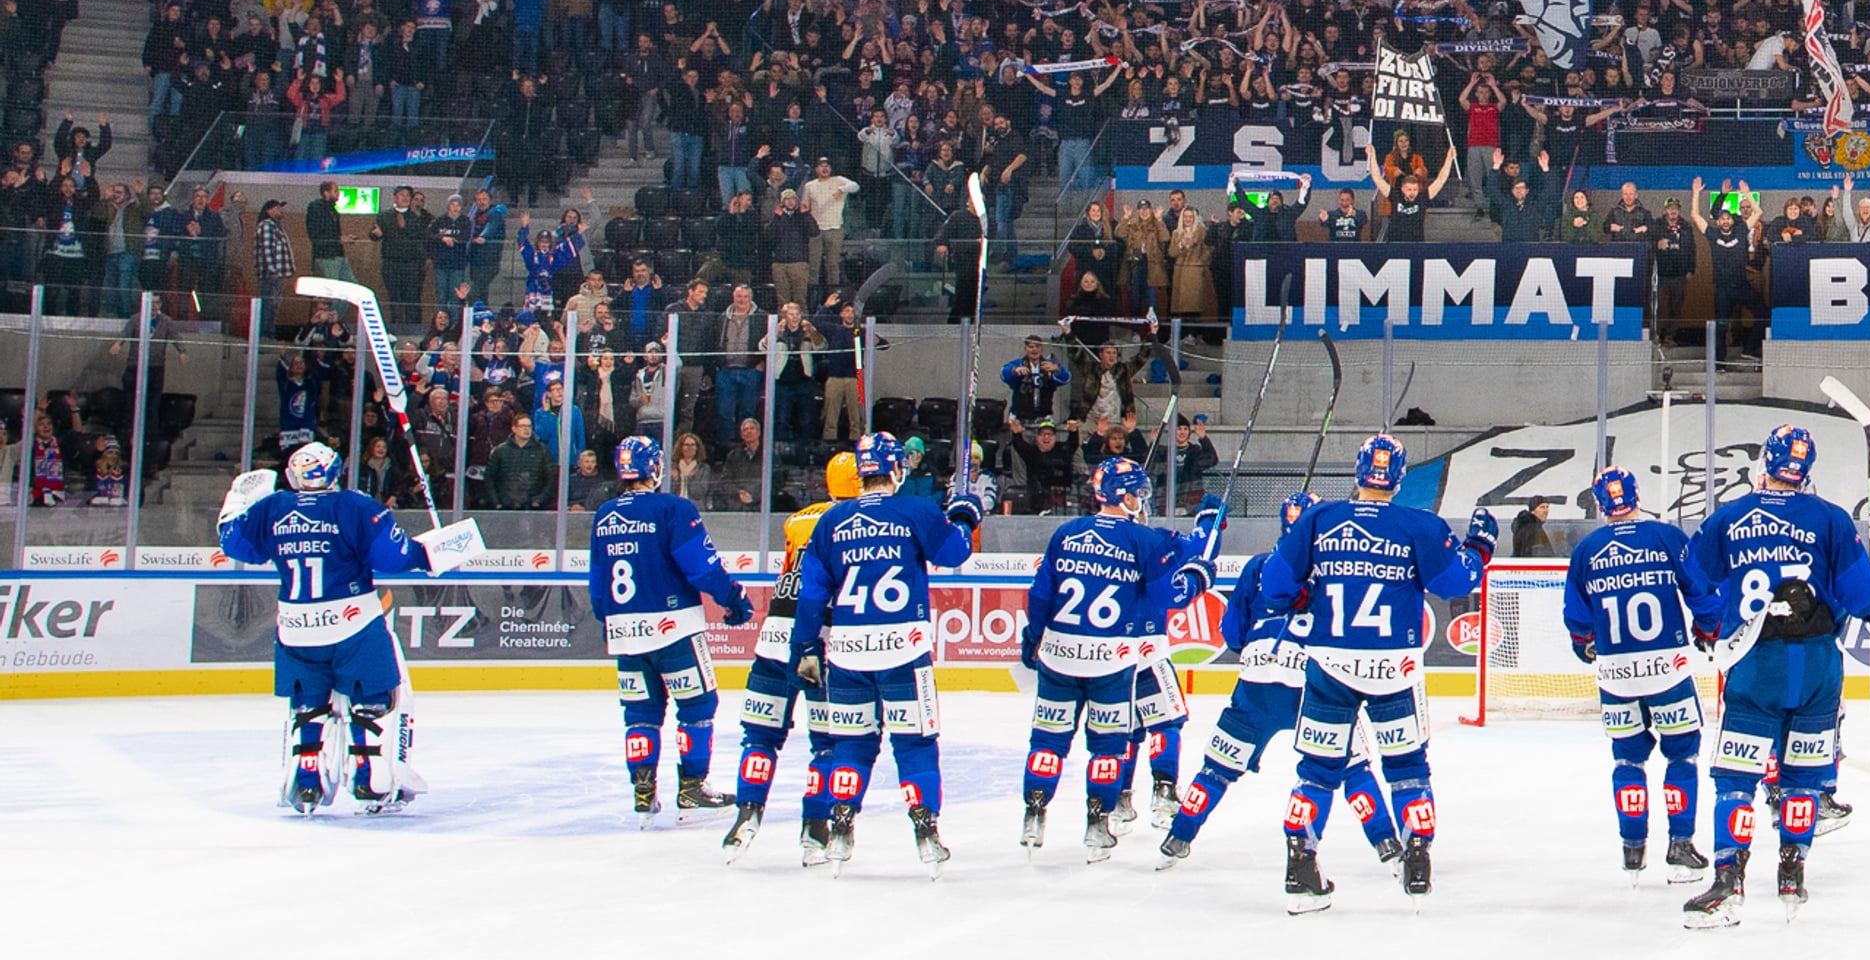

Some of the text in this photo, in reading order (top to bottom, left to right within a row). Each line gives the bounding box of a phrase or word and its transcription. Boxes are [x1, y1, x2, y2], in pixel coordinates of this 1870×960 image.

[1455, 44, 1511, 52] DIVISIN
[1544, 98, 1602, 106] DIVISIN
[1401, 102, 1444, 123] ALL
[1245, 258, 1633, 326] LIMMAT
[1727, 522, 1816, 544] immoZins
[278, 541, 330, 555] HRUBEC
[607, 542, 639, 556] RIEDI
[842, 545, 901, 564] KUKAN
[1061, 536, 1135, 563] immoZins
[1314, 539, 1411, 558] immoZins
[30, 554, 93, 565] SwissLife
[141, 554, 203, 565] SwissLife
[974, 559, 1027, 571] SwissLife
[1589, 548, 1668, 570] immoZins
[287, 557, 323, 599] 11
[611, 560, 636, 604] 8
[836, 566, 910, 614] 46
[500, 606, 524, 619] Die
[1053, 578, 1121, 629] 26
[1326, 583, 1392, 637] 14
[500, 619, 575, 634] Cheminée-
[1168, 595, 1211, 641] ell
[1601, 592, 1663, 644] 10
[500, 635, 572, 649] Kreateure.
[745, 697, 774, 716] ewz
[1037, 704, 1066, 721] ewz
[1090, 709, 1120, 723] ewz
[1654, 707, 1689, 724] ewz
[832, 709, 864, 726] ewz
[1603, 710, 1633, 726] ewz
[1303, 725, 1338, 746] ewz
[1211, 734, 1241, 759] ewz
[1723, 740, 1759, 759] ewz
[1792, 739, 1824, 754] ewz
[1788, 801, 1811, 826] marti
